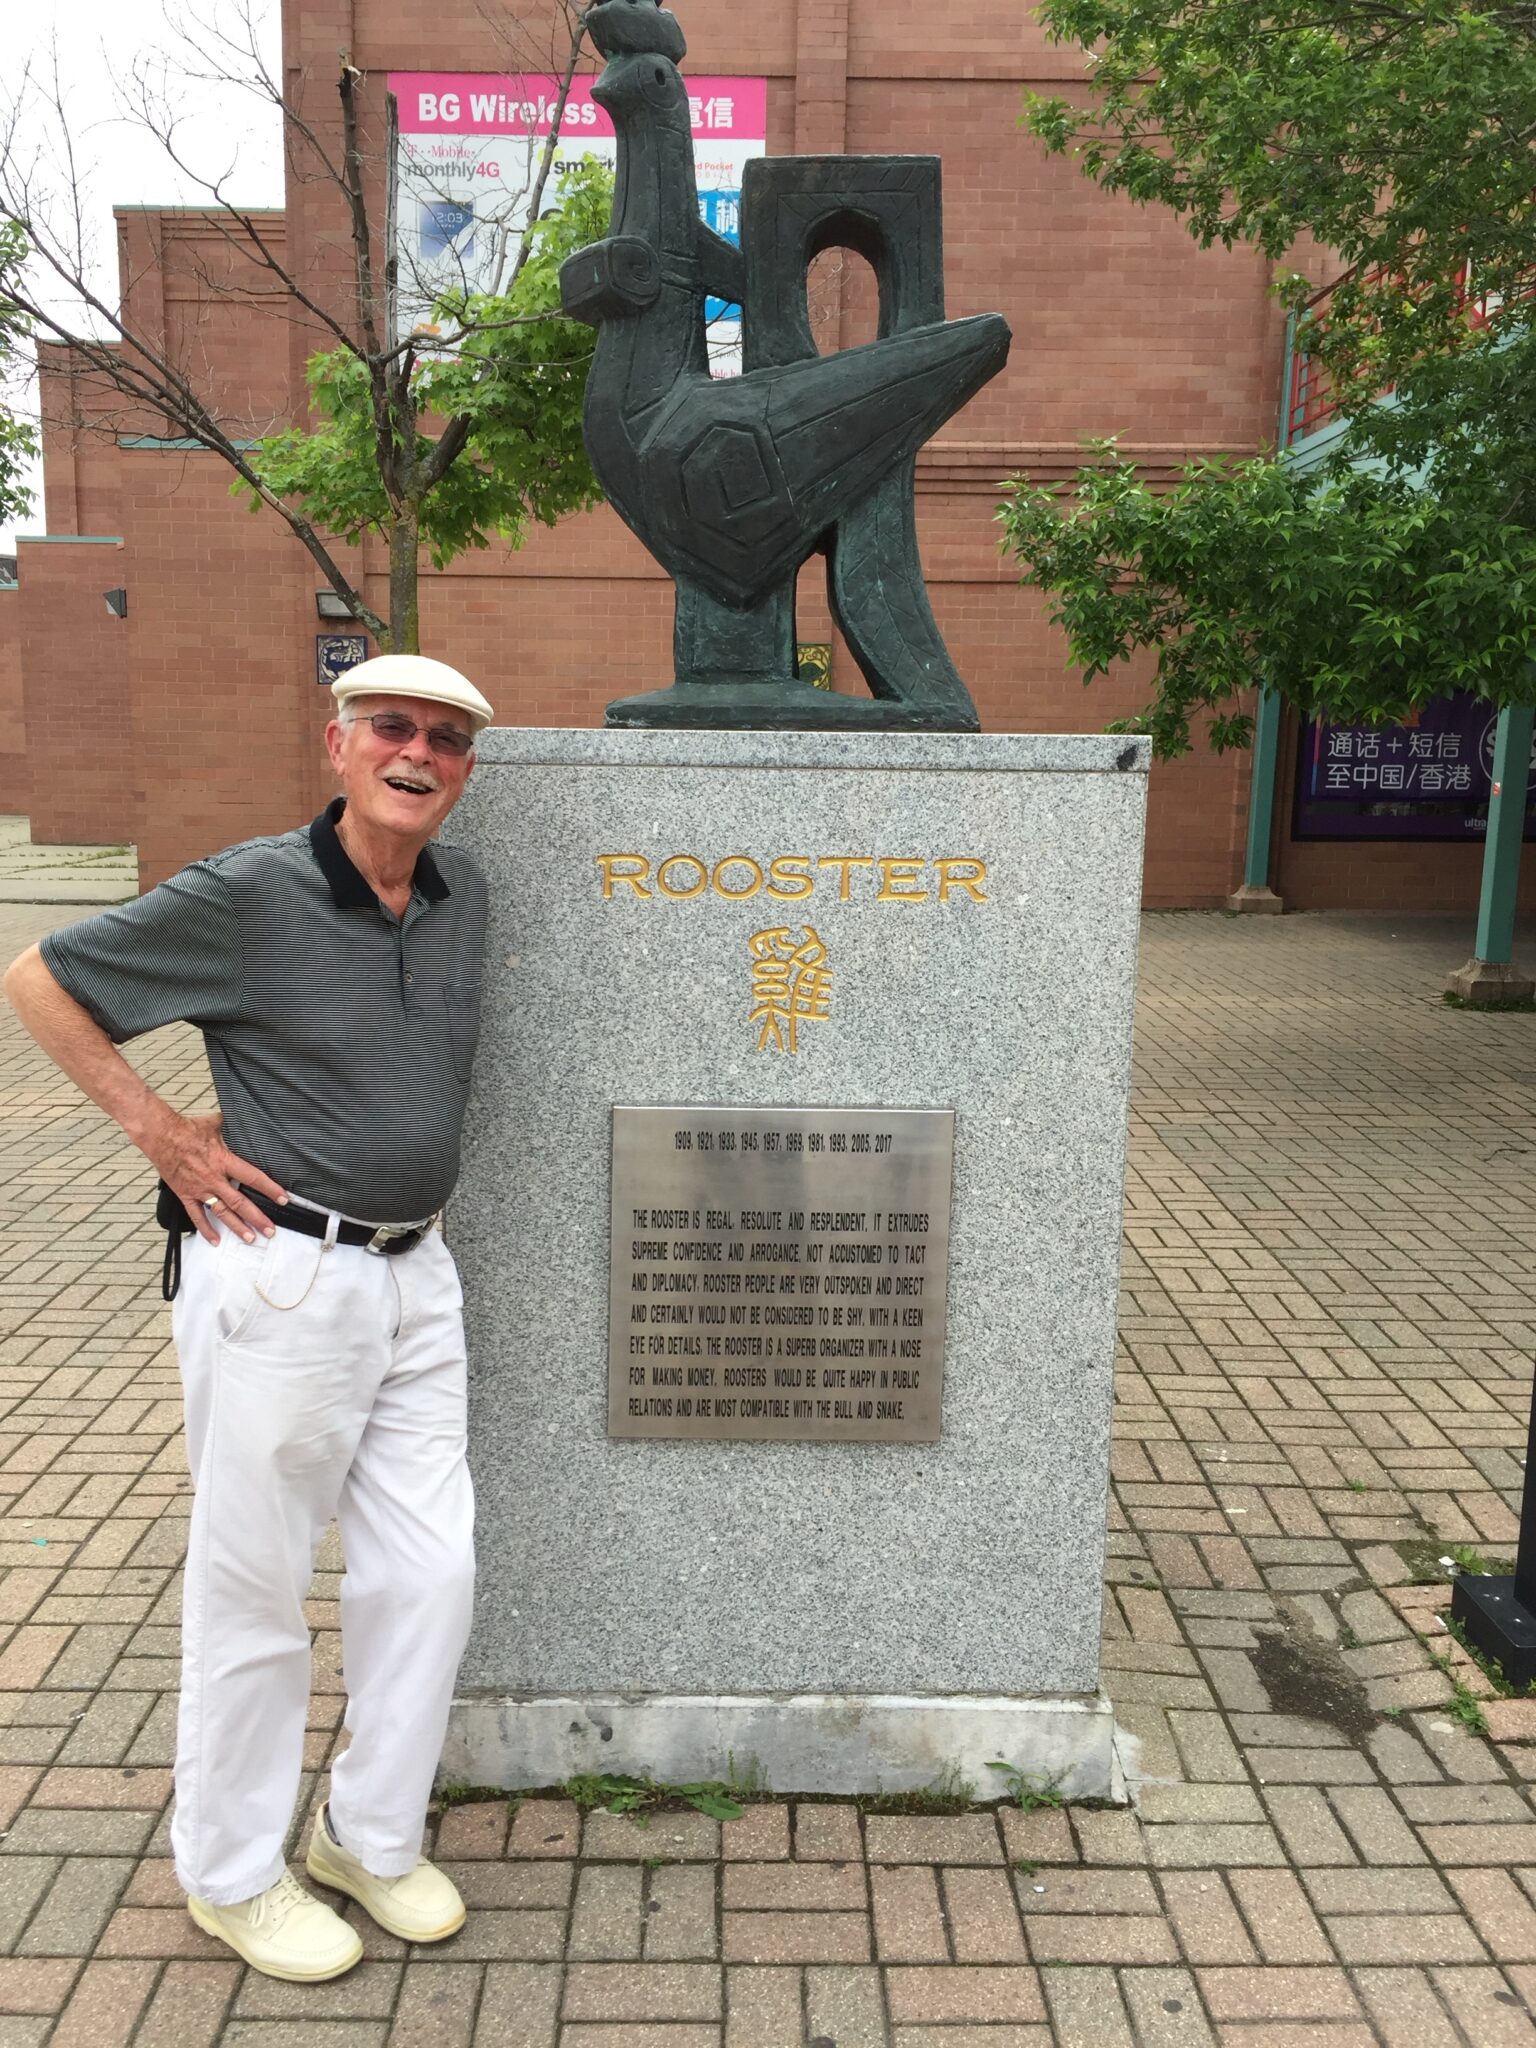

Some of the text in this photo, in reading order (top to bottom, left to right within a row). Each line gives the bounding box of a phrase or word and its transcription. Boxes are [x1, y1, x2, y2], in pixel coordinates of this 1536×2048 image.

[418, 93, 597, 125] BG Wireless
[407, 161, 500, 181] monthly4G
[1325, 763, 1472, 790] 至中国/香港
[596, 853, 988, 903] ROOSTER
[875, 1134, 892, 1153] 2017
[633, 1209, 647, 1228] THE
[652, 1210, 689, 1229] ROOSTER
[693, 1211, 700, 1229] IS
[741, 1211, 781, 1230] RESOLUTE
[788, 1212, 804, 1230] AND
[874, 1213, 881, 1231] IT
[888, 1213, 928, 1232] EXTRUDES
[632, 1241, 668, 1260] SUPREME
[673, 1242, 722, 1260] CONFIDENCE
[728, 1243, 744, 1261] AND
[807, 1244, 823, 1262] NOT
[829, 1244, 882, 1263] ACCUSTOMED
[888, 1245, 898, 1263] TO
[905, 1245, 926, 1264] TACT
[632, 1273, 647, 1291] AND
[703, 1274, 740, 1293] ROOSTER
[745, 1274, 775, 1293] PEOPLE
[779, 1275, 795, 1293] ARE
[800, 1275, 820, 1294] VERY
[824, 1275, 872, 1295] OUTSPOKEN
[876, 1276, 892, 1295] AND
[896, 1277, 924, 1295] DIRECT
[631, 1304, 646, 1322] AND
[651, 1304, 694, 1323] CERTAINLY
[698, 1306, 726, 1324] WOULD
[730, 1306, 746, 1324] NOT
[750, 1306, 760, 1324] BE
[765, 1306, 813, 1325] CONSIDERED
[818, 1307, 829, 1325] TO
[833, 1307, 843, 1325] BE
[869, 1308, 889, 1326] WITH
[892, 1308, 898, 1326] A
[902, 1308, 923, 1326] KEEN
[630, 1335, 645, 1354] EYE
[648, 1335, 665, 1354] FOR
[707, 1337, 721, 1355] THE
[725, 1337, 762, 1355] ROOSTER
[765, 1337, 773, 1356] IS
[776, 1338, 782, 1355] A
[786, 1338, 816, 1356] SUPERB
[820, 1338, 864, 1357] ORGANIZER
[868, 1339, 887, 1357] WITH
[891, 1339, 896, 1357] A
[900, 1339, 921, 1357] NOSE
[629, 1367, 645, 1385] FOR
[652, 1367, 683, 1386] MAKING
[724, 1368, 767, 1386] ROOSTERS
[774, 1368, 802, 1387] WOULD
[806, 1369, 816, 1387] BE
[823, 1369, 846, 1388] QUITE
[850, 1369, 876, 1388] HAPPY
[880, 1370, 888, 1388] IN
[892, 1370, 920, 1388] PUBLIC
[628, 1398, 672, 1416] RELATIONS
[676, 1398, 692, 1416] AND
[696, 1399, 711, 1416] ARE
[715, 1399, 737, 1417] MOST
[740, 1399, 789, 1417] COMPATIBLE
[793, 1400, 813, 1417] WITH
[817, 1400, 831, 1418] THE
[834, 1401, 853, 1418] BULL
[857, 1401, 873, 1419] AND
